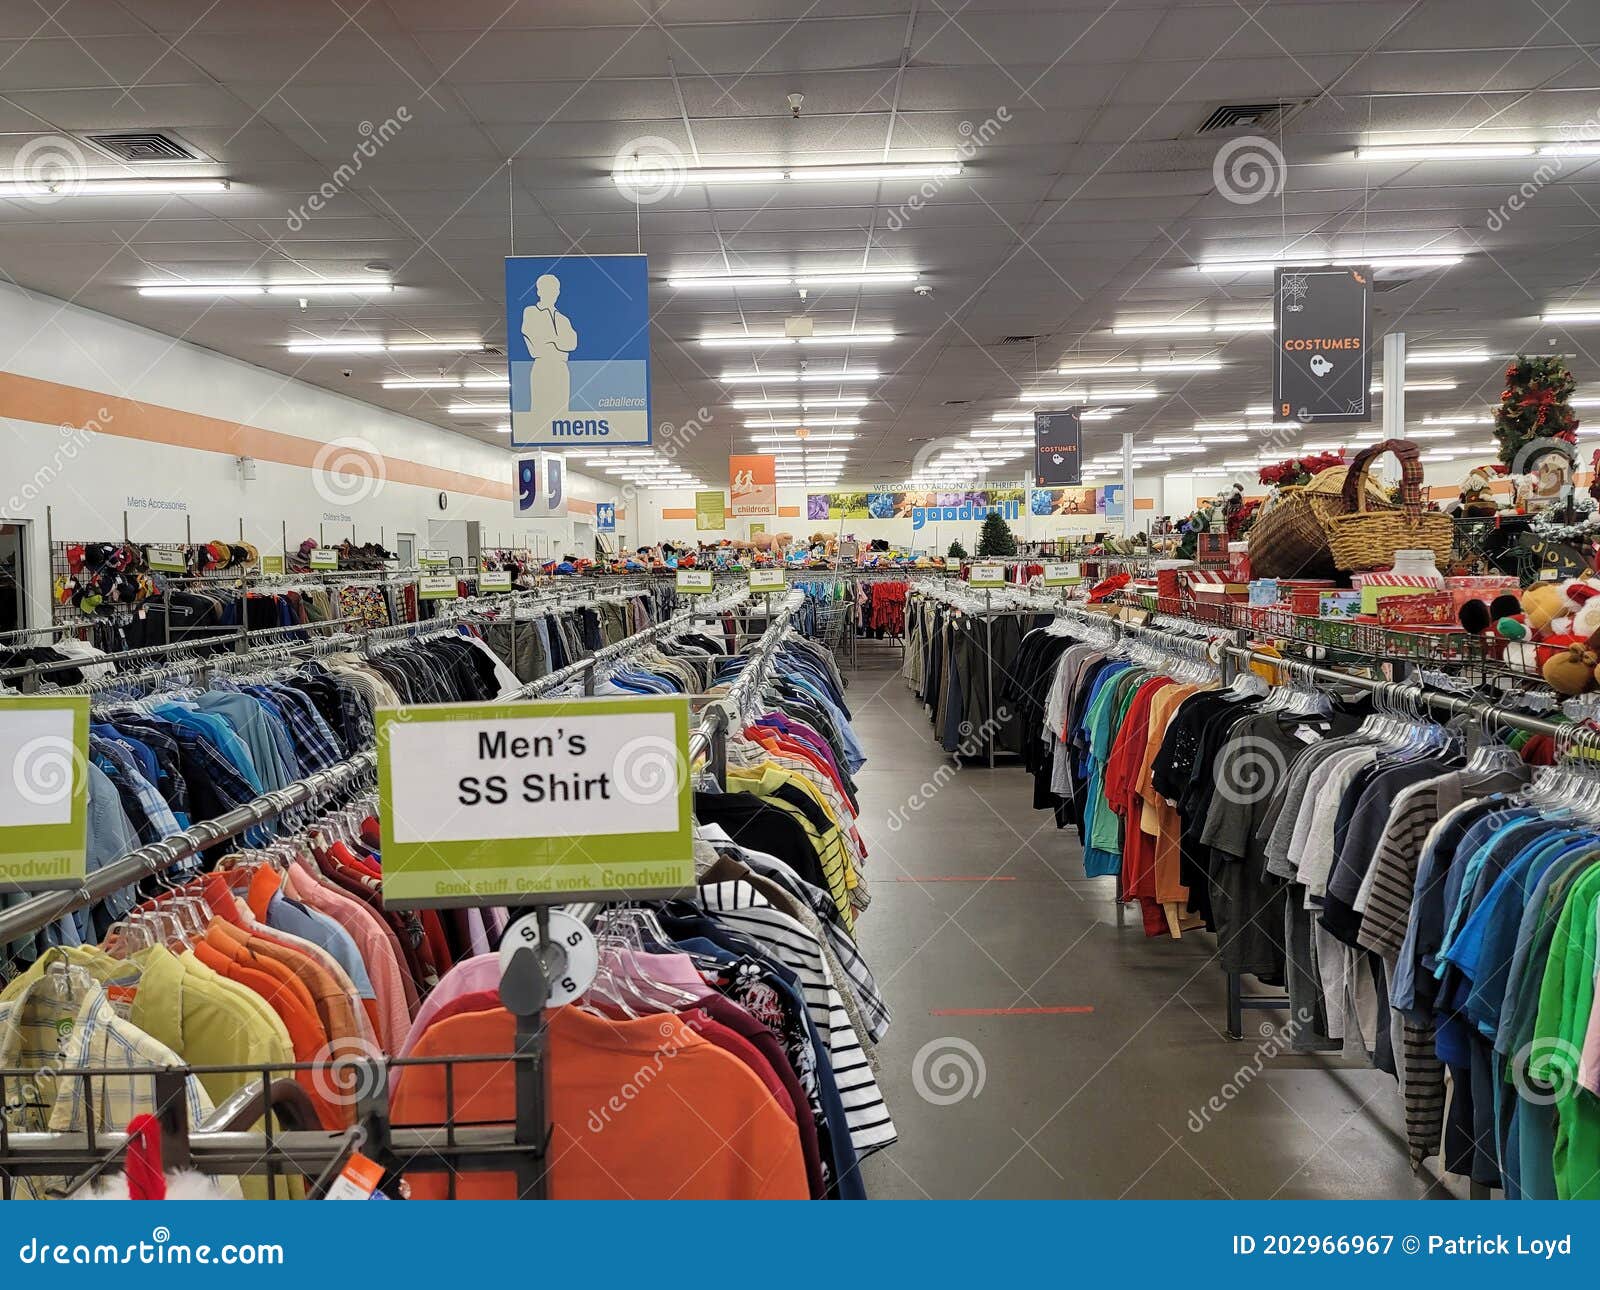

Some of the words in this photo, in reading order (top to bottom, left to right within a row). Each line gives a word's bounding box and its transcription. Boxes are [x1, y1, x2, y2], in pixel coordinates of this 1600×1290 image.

[1285, 338, 1360, 350] COSTUMES
[598, 396, 645, 408] caballeros
[552, 419, 609, 436] mens
[1040, 445, 1076, 453] COSTUMES
[873, 483, 915, 491] WELCOME
[918, 483, 928, 491] TO
[991, 481, 1017, 489] THRIFT
[737, 504, 770, 513] childrens
[912, 500, 1019, 530] goodwill
[478, 728, 587, 760] Men's
[458, 775, 508, 806] SS
[522, 772, 611, 803] Shirt
[0, 857, 71, 877] oodwill
[435, 880, 473, 894] Good
[476, 878, 510, 893] stuff.
[556, 875, 596, 889] work.
[602, 867, 682, 887] Goodwill
[520, 926, 536, 942] S
[567, 931, 583, 946] S
[561, 977, 576, 993] S
